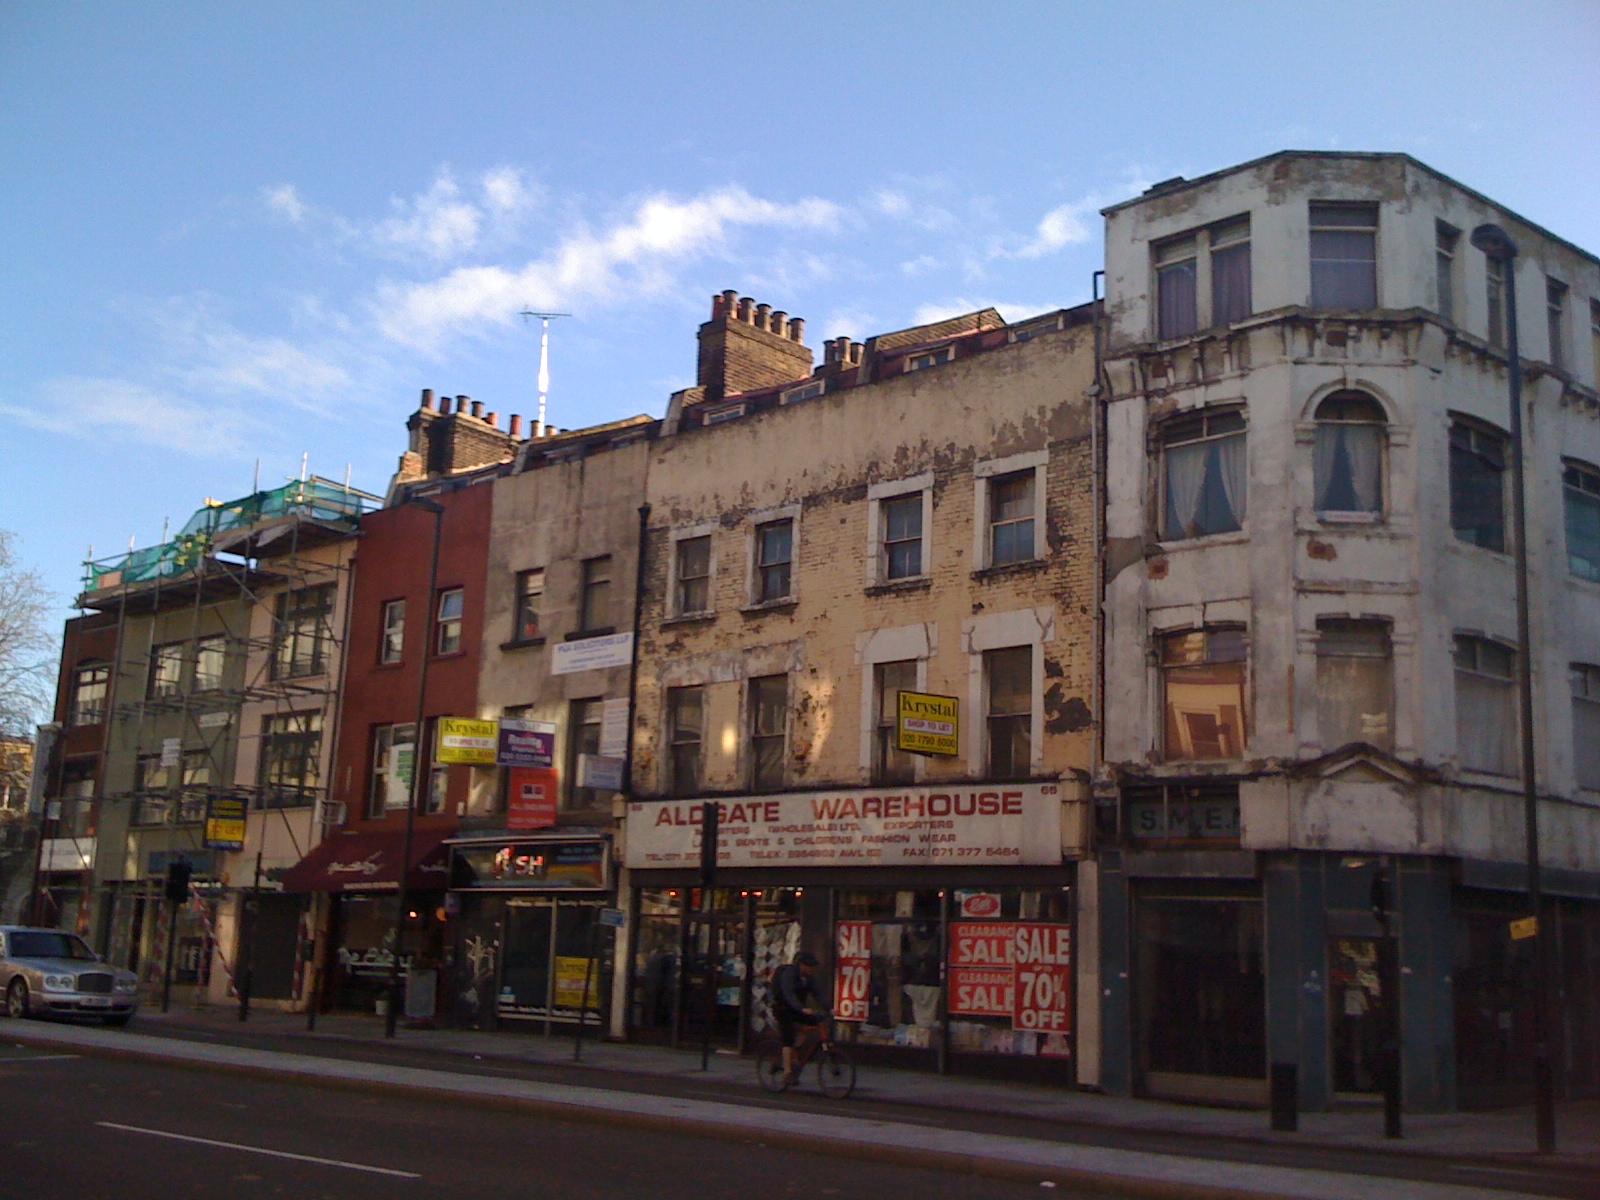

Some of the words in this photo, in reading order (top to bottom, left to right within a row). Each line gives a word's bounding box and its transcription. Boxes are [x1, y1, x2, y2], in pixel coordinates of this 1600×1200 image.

[902, 694, 956, 717] Krystal
[444, 719, 494, 736] Krystal
[655, 801, 780, 827] ALDGATE
[810, 791, 1023, 821] WAREHOUSE
[883, 820, 954, 831] EXPORTERS
[861, 834, 910, 844] FASHION
[918, 833, 957, 843] WEAR
[957, 847, 982, 857] 377
[957, 926, 1015, 937] CLEARANC
[1016, 927, 1070, 965] SALE
[957, 972, 1014, 984] CLEARANC
[1020, 1009, 1066, 1029] OFF
